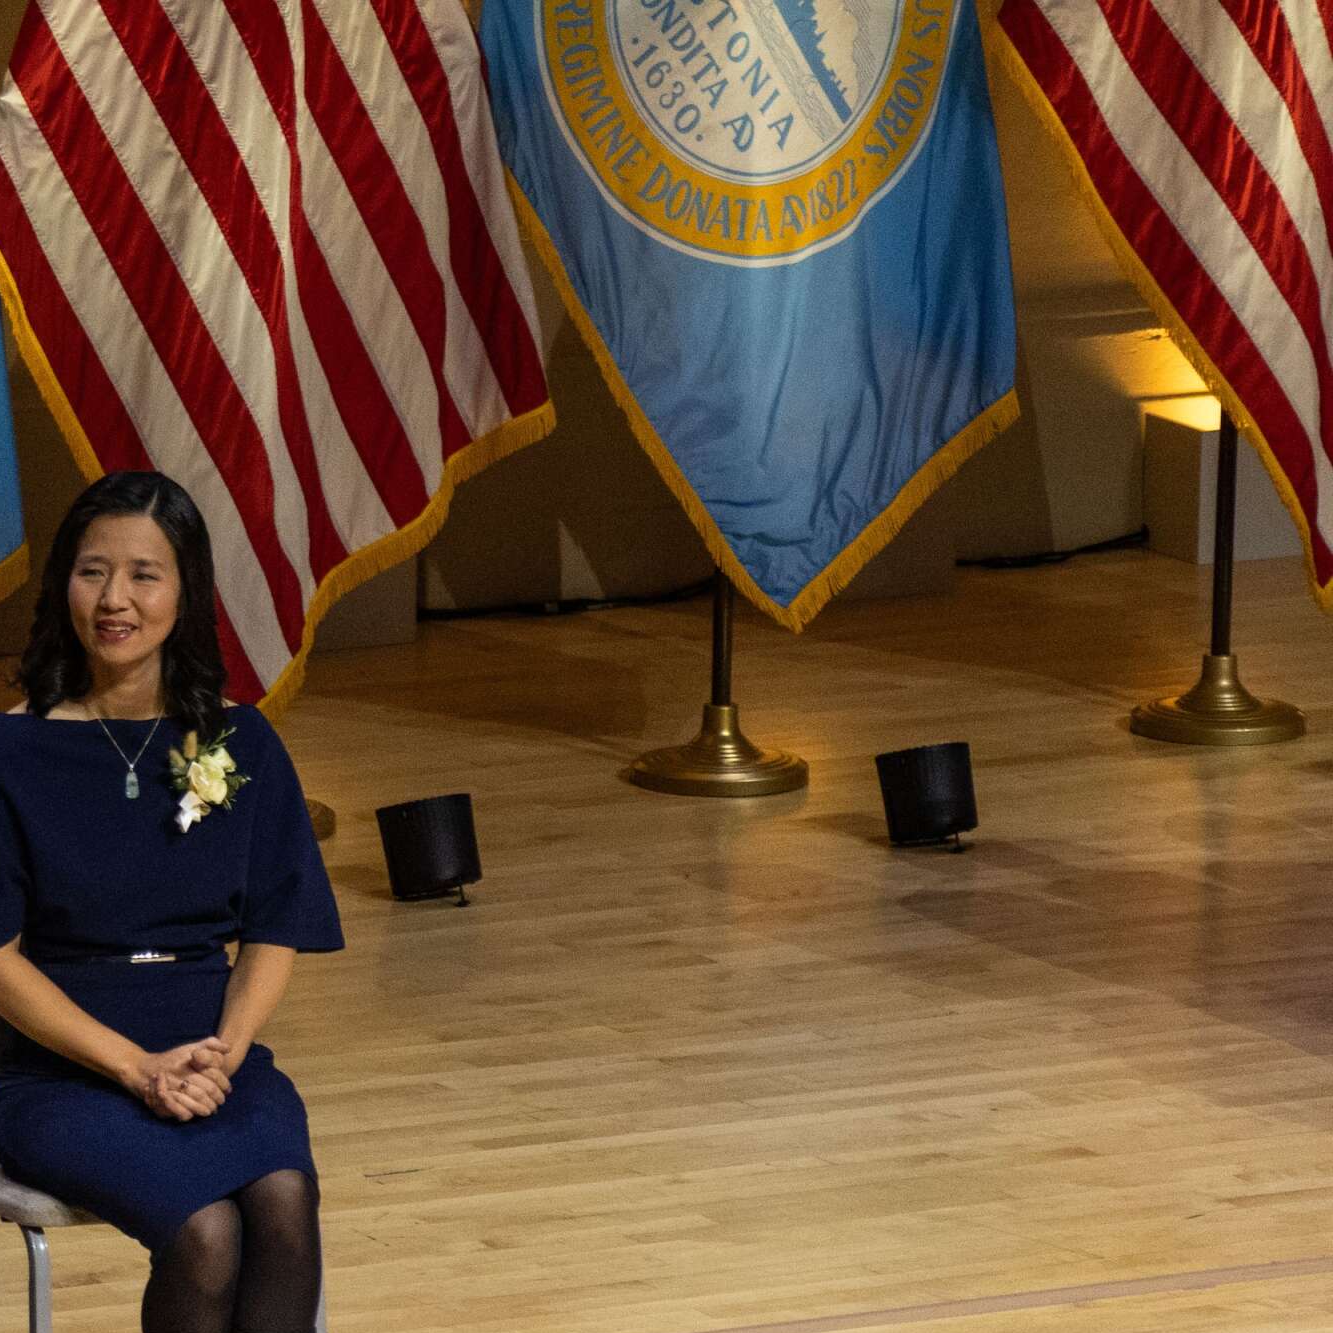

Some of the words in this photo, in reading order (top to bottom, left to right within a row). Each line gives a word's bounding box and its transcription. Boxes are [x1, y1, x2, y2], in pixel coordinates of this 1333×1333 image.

[641, 0, 729, 109] NDITA
[691, 0, 795, 150] TONIA
[637, 162, 773, 241] DONATA
